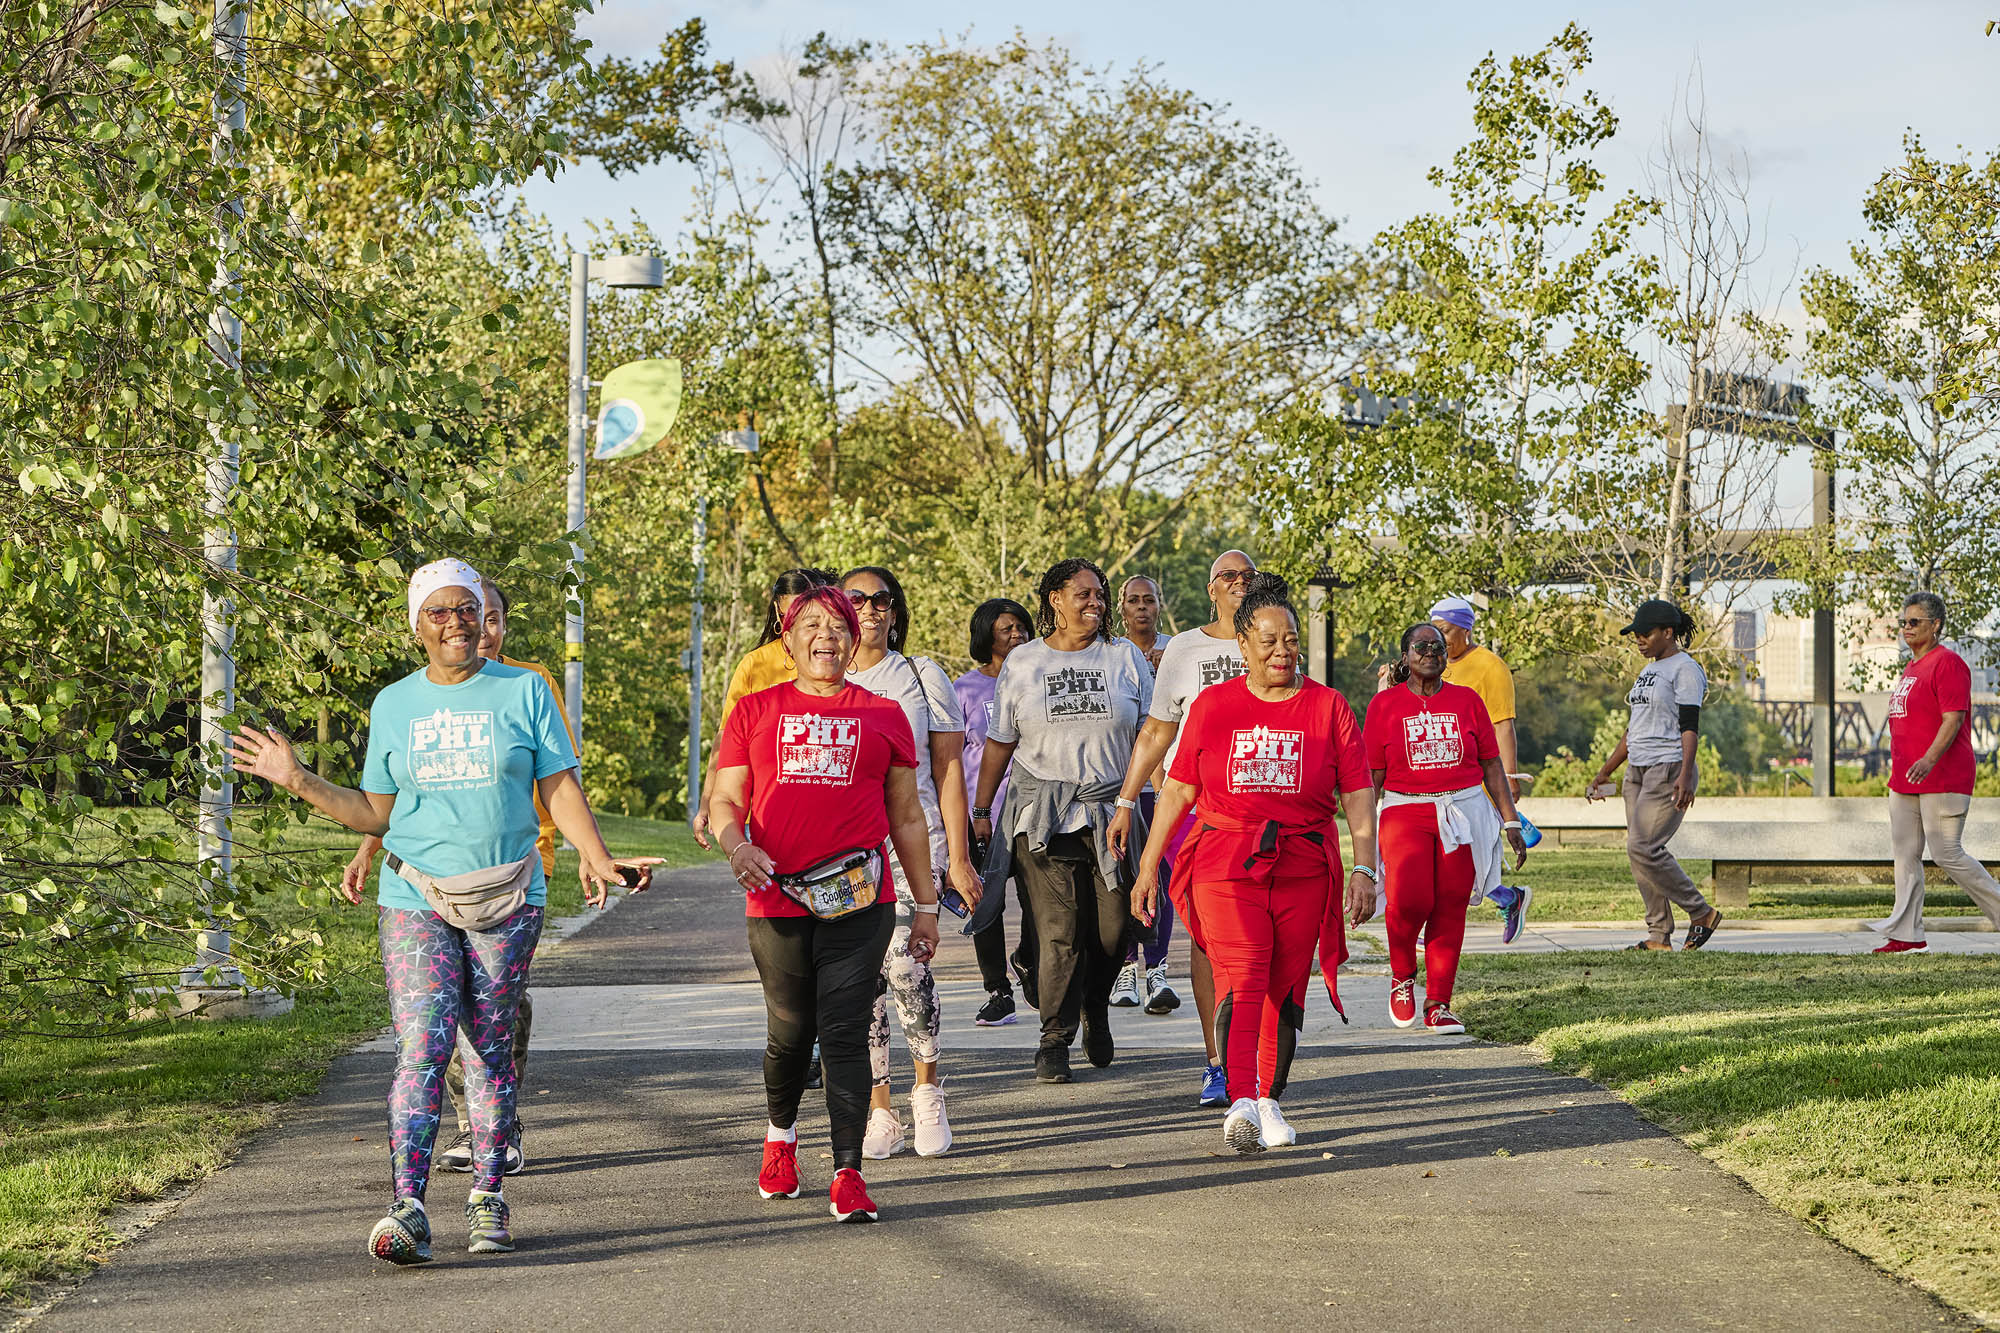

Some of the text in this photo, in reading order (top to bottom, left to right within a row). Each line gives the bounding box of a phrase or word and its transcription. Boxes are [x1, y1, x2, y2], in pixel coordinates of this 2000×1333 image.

[1202, 662, 1217, 670] WE
[1047, 677, 1105, 696] PHL
[451, 714, 489, 726] WALK
[1095, 714, 1109, 722] park
[1406, 715, 1456, 727] WE WALK
[412, 725, 490, 751] PHL
[781, 723, 856, 746] PHL
[1236, 733, 1300, 742] WE WALK
[1407, 723, 1459, 742] PHL
[1232, 741, 1299, 760] PHL
[831, 779, 848, 788] park
[1280, 787, 1296, 796] park
[821, 880, 868, 904] Coppertone
